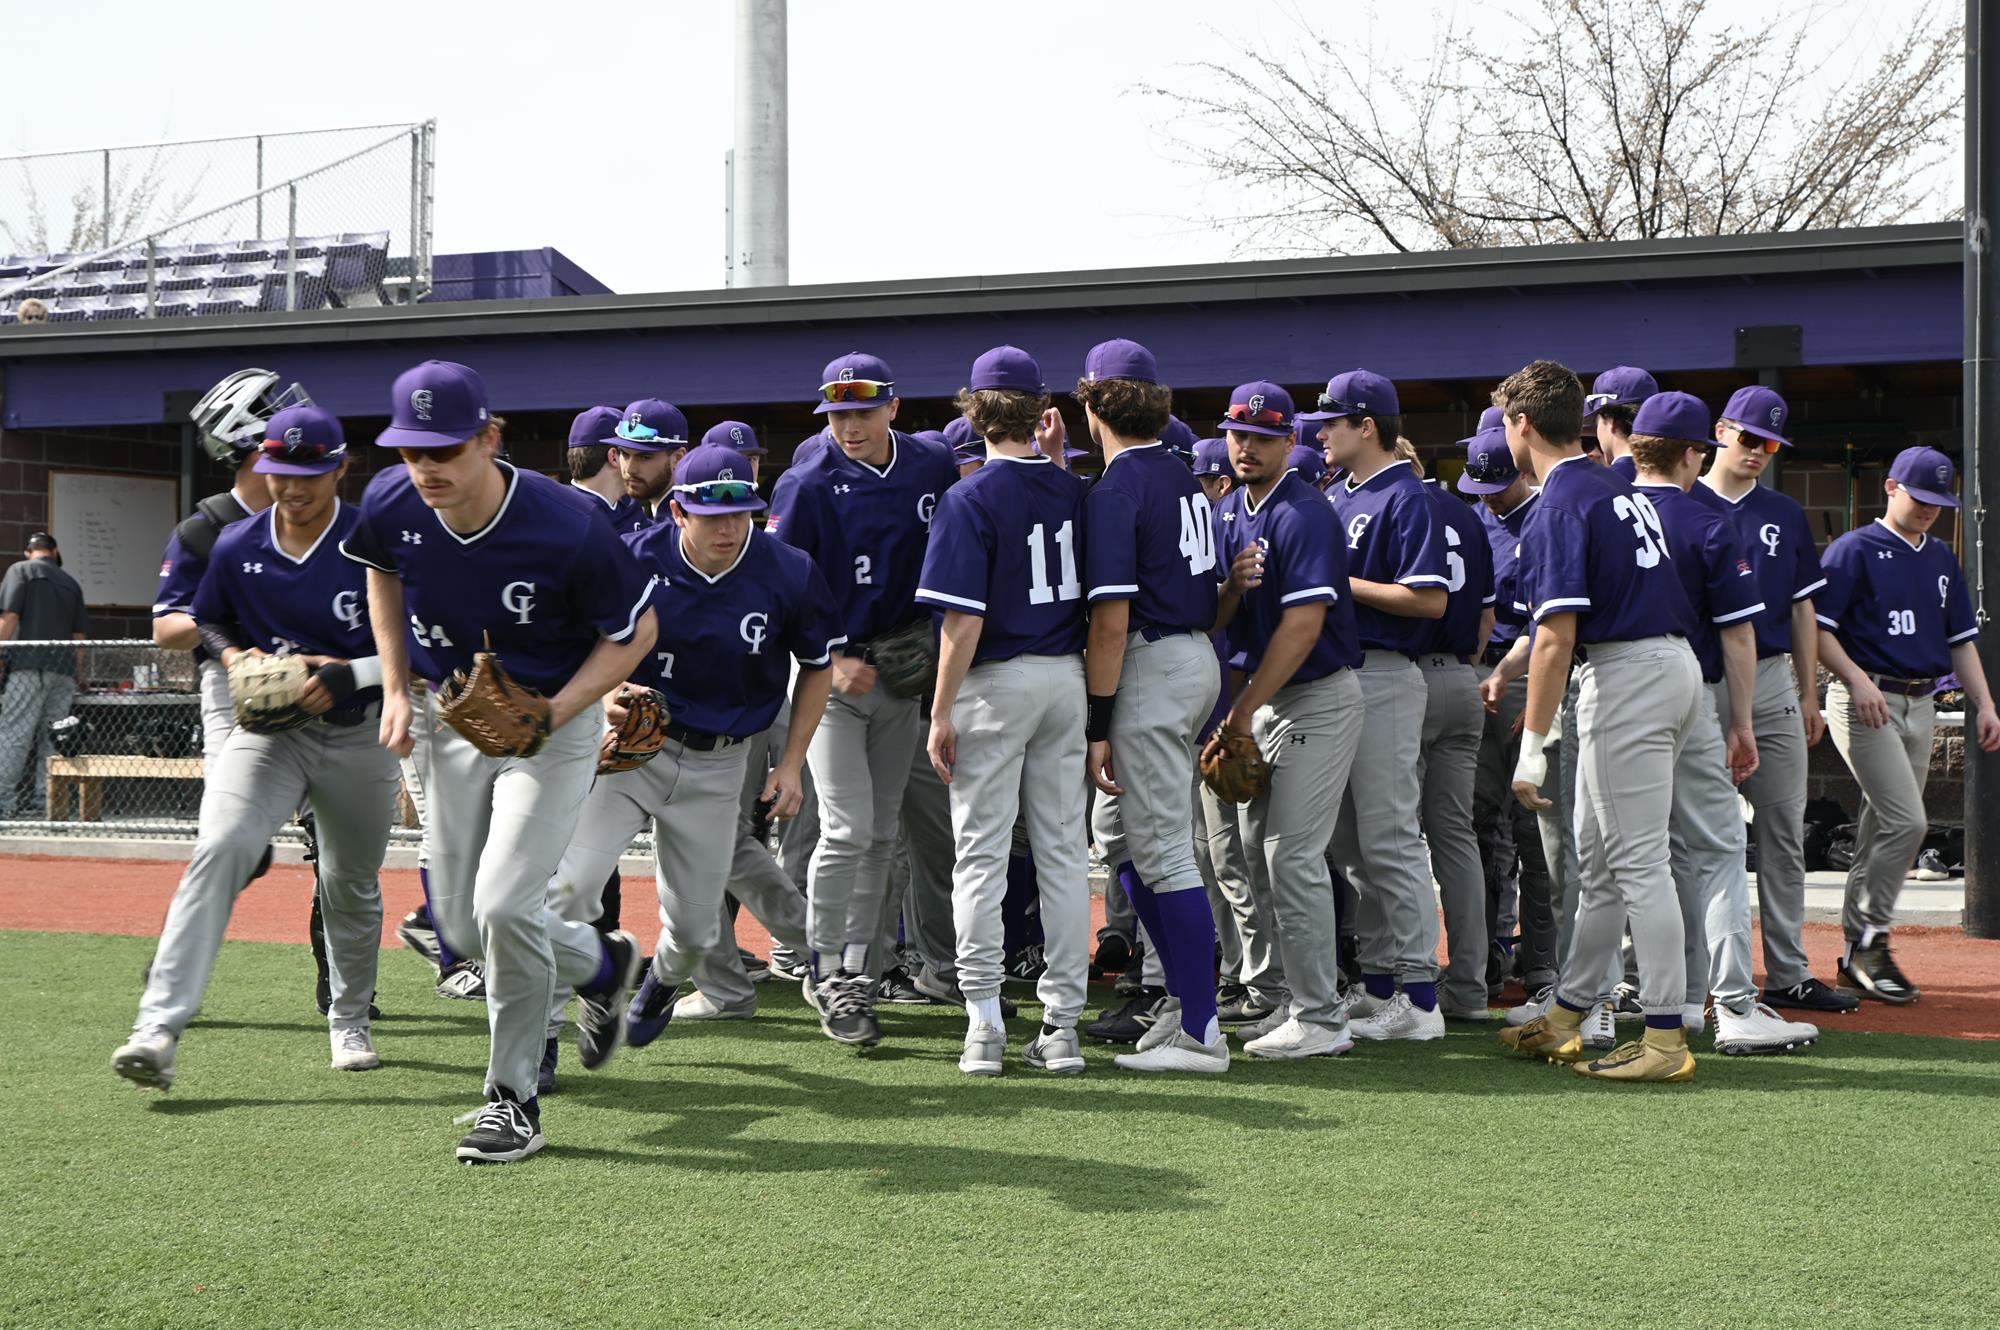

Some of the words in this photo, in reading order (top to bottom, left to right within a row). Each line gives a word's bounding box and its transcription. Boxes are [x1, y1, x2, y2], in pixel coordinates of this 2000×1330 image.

[1179, 493, 1217, 576] 40
[1613, 492, 1671, 569] 39
[855, 555, 872, 585] 2
[1027, 520, 1082, 605] 11
[410, 614, 455, 648] 24
[1887, 609, 1917, 636] 30
[657, 652, 675, 679] 7
